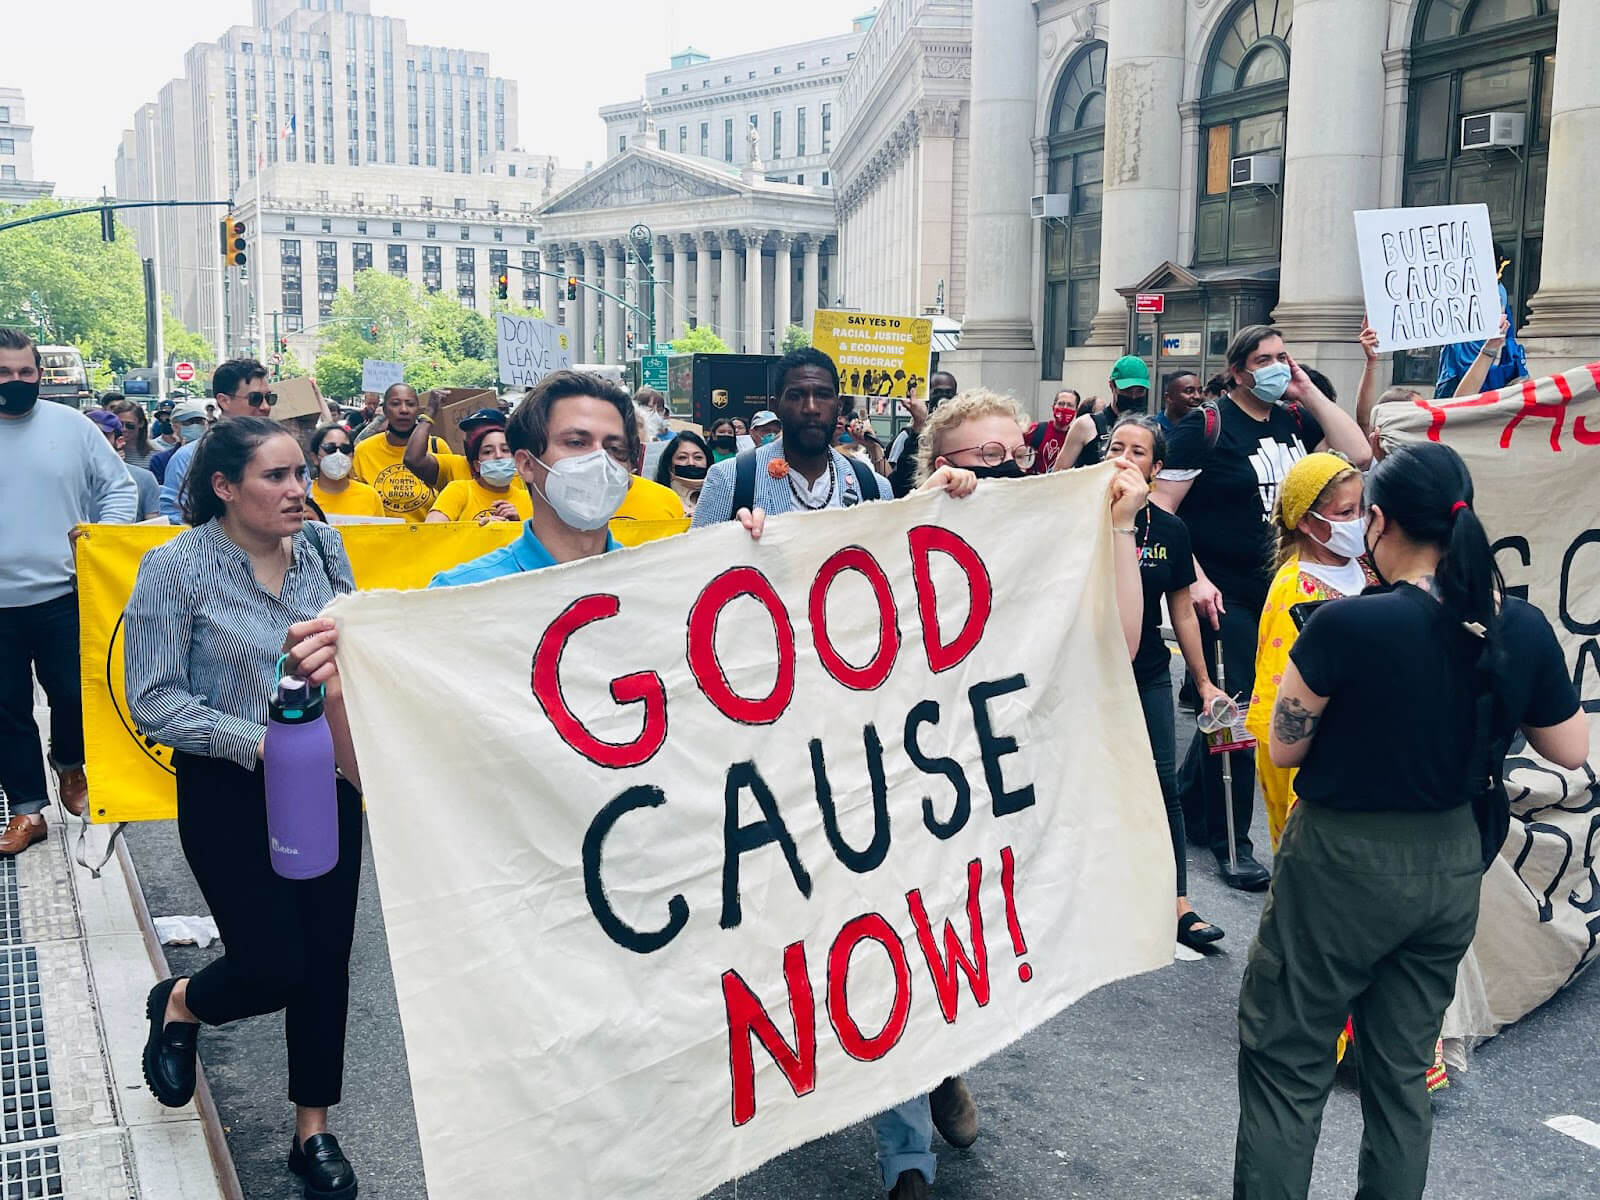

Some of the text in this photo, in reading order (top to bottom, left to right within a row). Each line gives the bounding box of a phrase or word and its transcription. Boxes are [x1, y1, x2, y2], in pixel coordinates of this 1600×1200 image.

[1382, 221, 1476, 266] BUENA
[1385, 257, 1481, 301] CAUSA
[848, 316, 901, 328] SAY YES TO
[1392, 295, 1485, 340] AHORA
[832, 327, 871, 340] RACIAL
[872, 331, 912, 343] JUSTICE
[1163, 338, 1180, 349] NYC
[507, 344, 551, 370] LEAVE
[839, 355, 904, 368] DEMOCRACY
[850, 343, 905, 355] ECONOMIC
[389, 490, 415, 498] BRONX
[531, 524, 992, 769] GOOD
[581, 673, 1036, 954] CAUSE
[721, 846, 1033, 1127] NOW!
